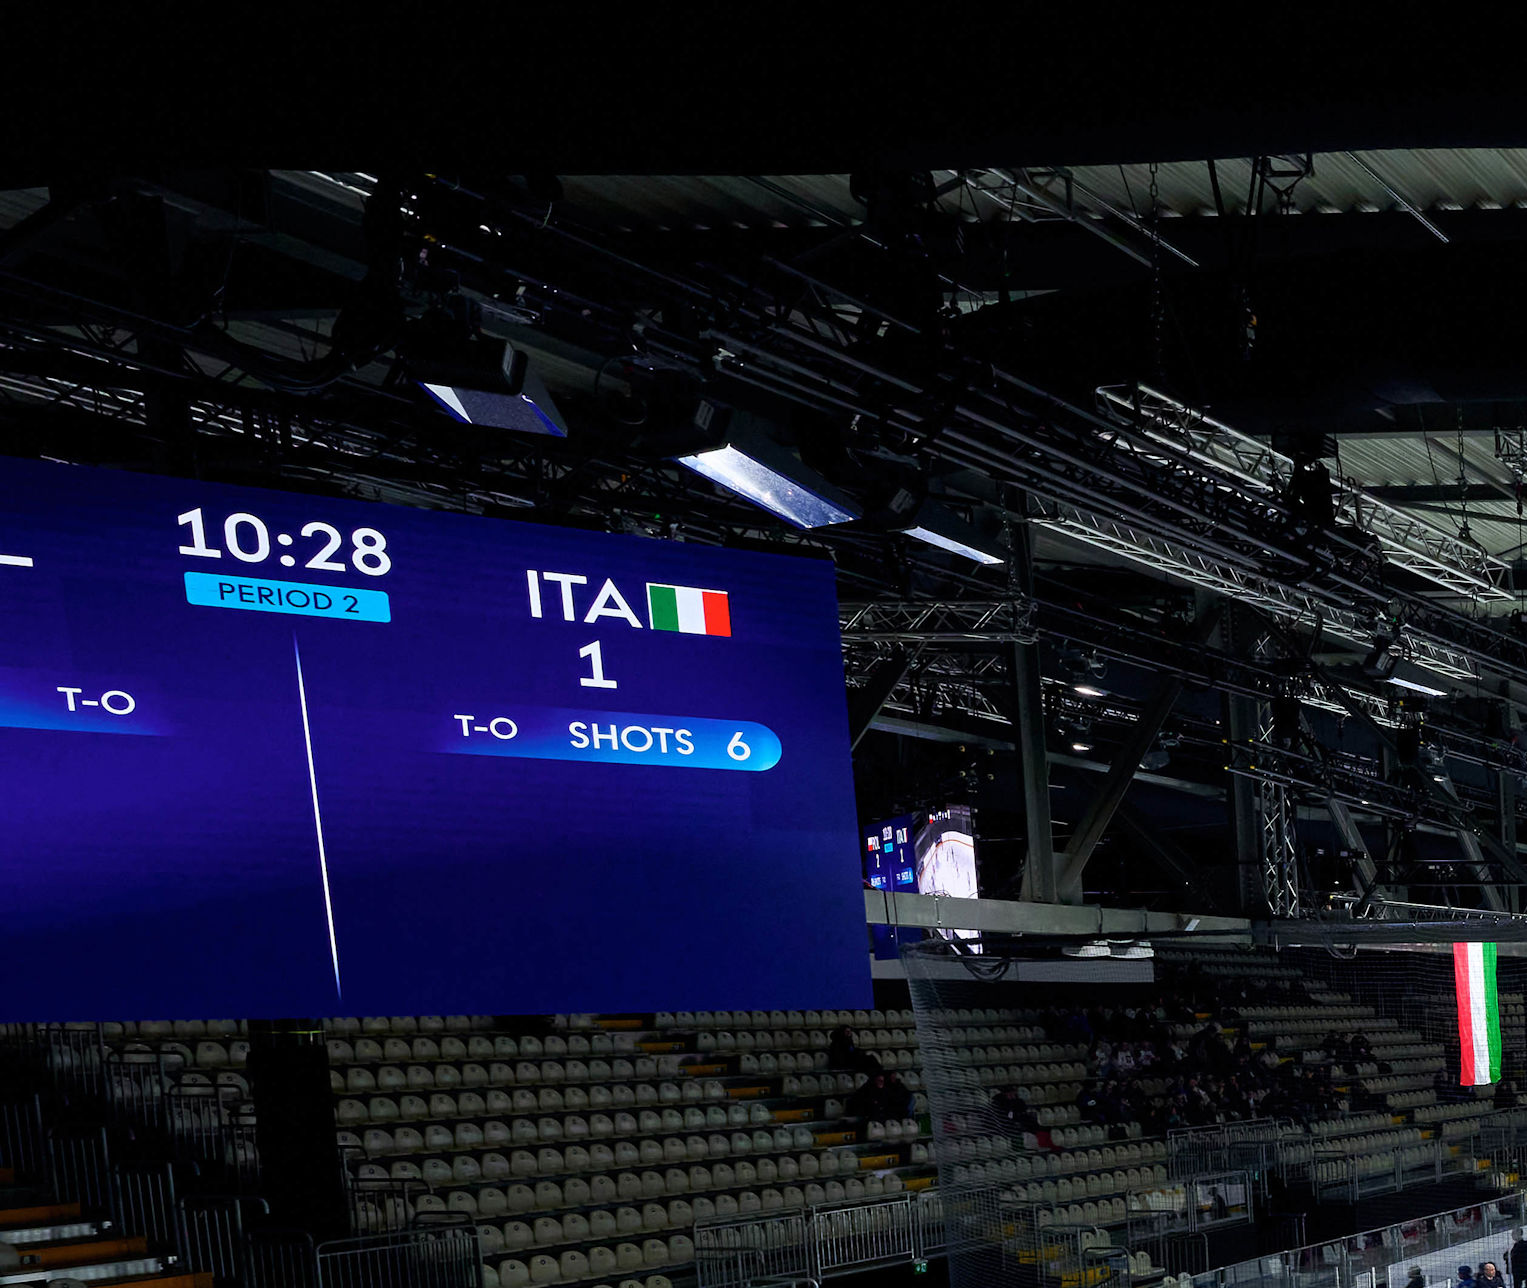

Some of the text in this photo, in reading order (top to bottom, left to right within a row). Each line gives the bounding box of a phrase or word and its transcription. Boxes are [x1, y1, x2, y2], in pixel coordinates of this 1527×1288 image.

[177, 507, 392, 577] 10:28
[218, 582, 361, 615] PERIOD 2
[526, 569, 643, 629] ITA
[578, 639, 618, 690] 1
[56, 686, 136, 716] T-O
[454, 714, 752, 761] T-O SHOTS 6
